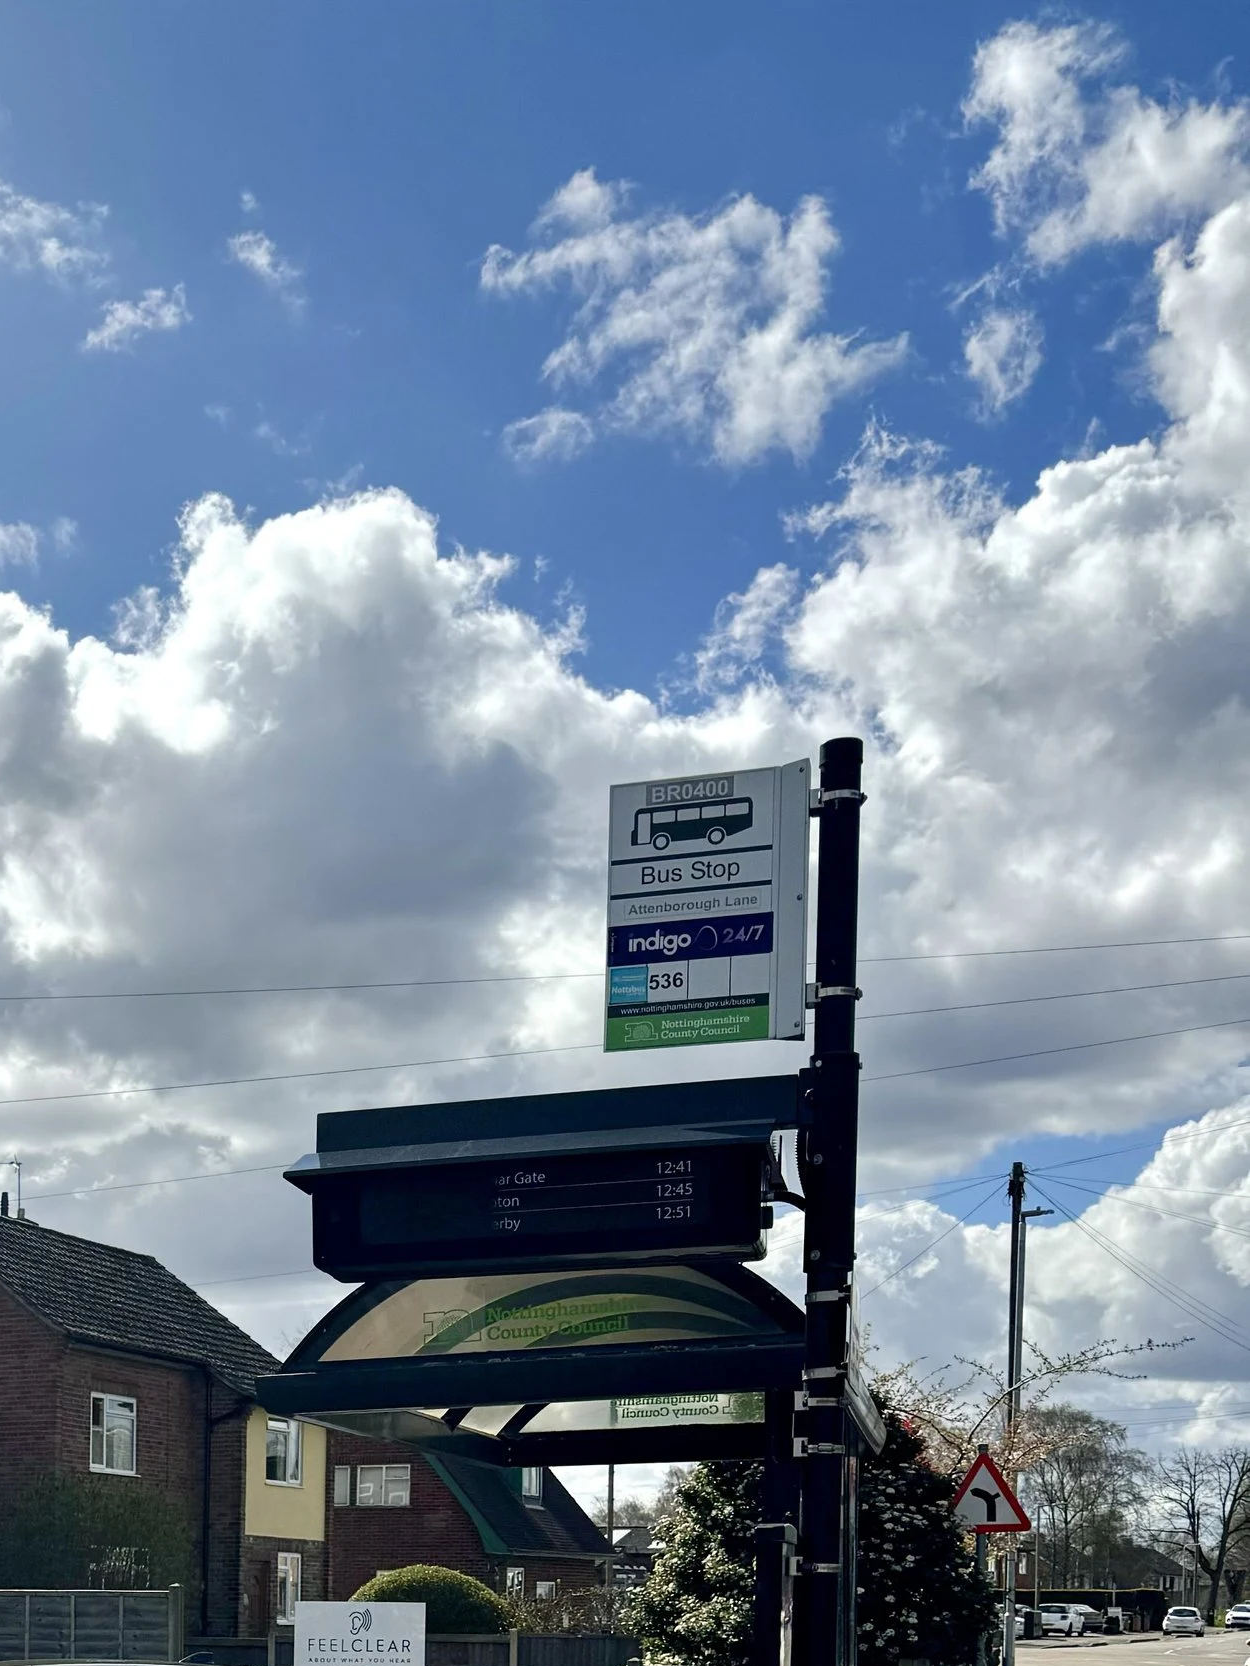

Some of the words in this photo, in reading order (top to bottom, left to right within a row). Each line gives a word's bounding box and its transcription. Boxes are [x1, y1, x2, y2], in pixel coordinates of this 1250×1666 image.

[651, 779, 729, 803] BR0400
[641, 865, 683, 885] Bus
[690, 860, 740, 882] Stop
[628, 897, 720, 916] Attenborough
[725, 894, 758, 907] Lane
[628, 929, 692, 956] indigo
[722, 924, 764, 944] 24/7
[649, 972, 684, 990] 536
[620, 997, 756, 1015] www.nottinghamshire.gov.uk/buses
[661, 1014, 750, 1029] Nottinghamshire
[661, 1029, 699, 1039] County
[700, 1025, 740, 1036] Council
[656, 1160, 692, 1175] 12:41
[514, 1171, 546, 1185] Gate
[656, 1183, 693, 1198] 12:45
[656, 1206, 692, 1220] 12:51
[486, 1325, 554, 1342] County
[558, 1315, 629, 1335] Council
[308, 1638, 411, 1653] FEELCLEAR
